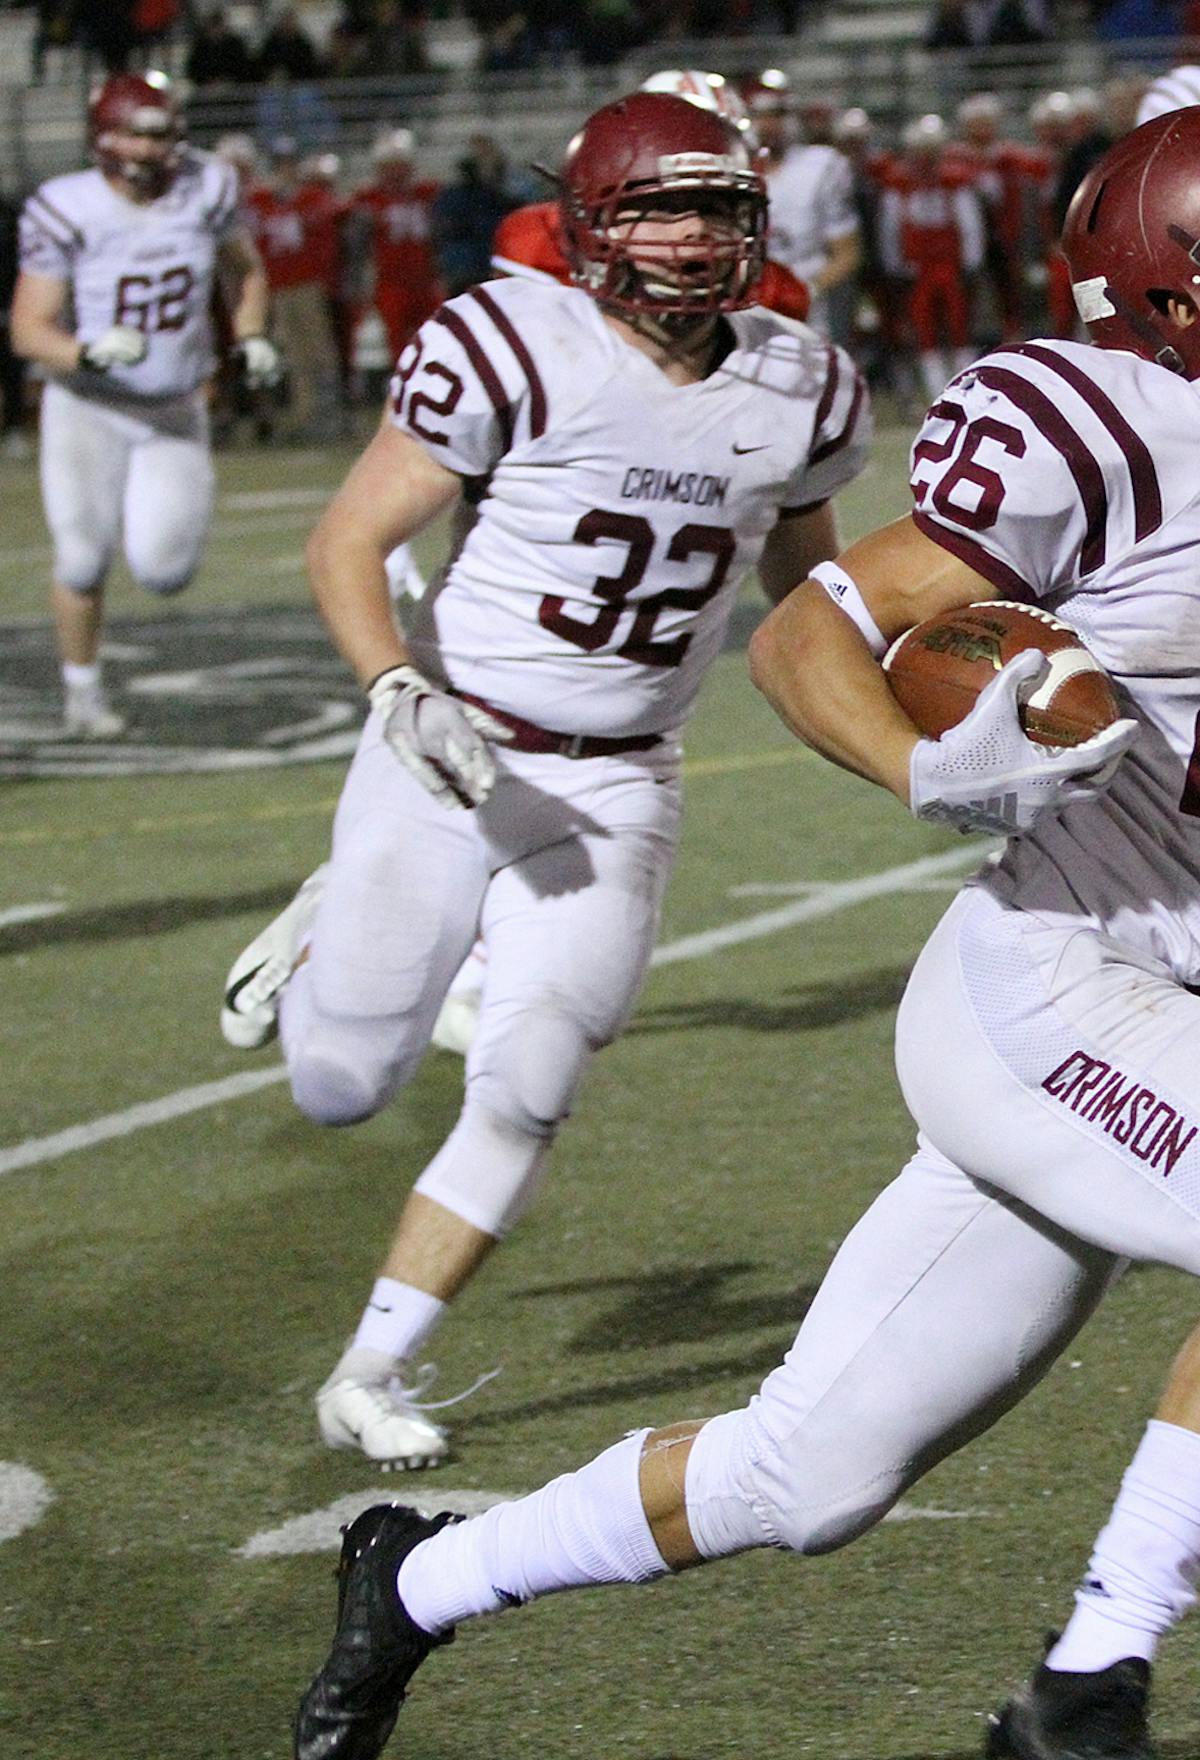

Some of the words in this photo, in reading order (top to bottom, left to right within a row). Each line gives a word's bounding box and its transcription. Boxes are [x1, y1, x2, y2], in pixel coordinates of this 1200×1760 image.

[622, 466, 732, 508] CRIMSON
[910, 399, 1027, 532] 26
[539, 508, 736, 668] 32
[1041, 1050, 1199, 1177] CRIMSON
